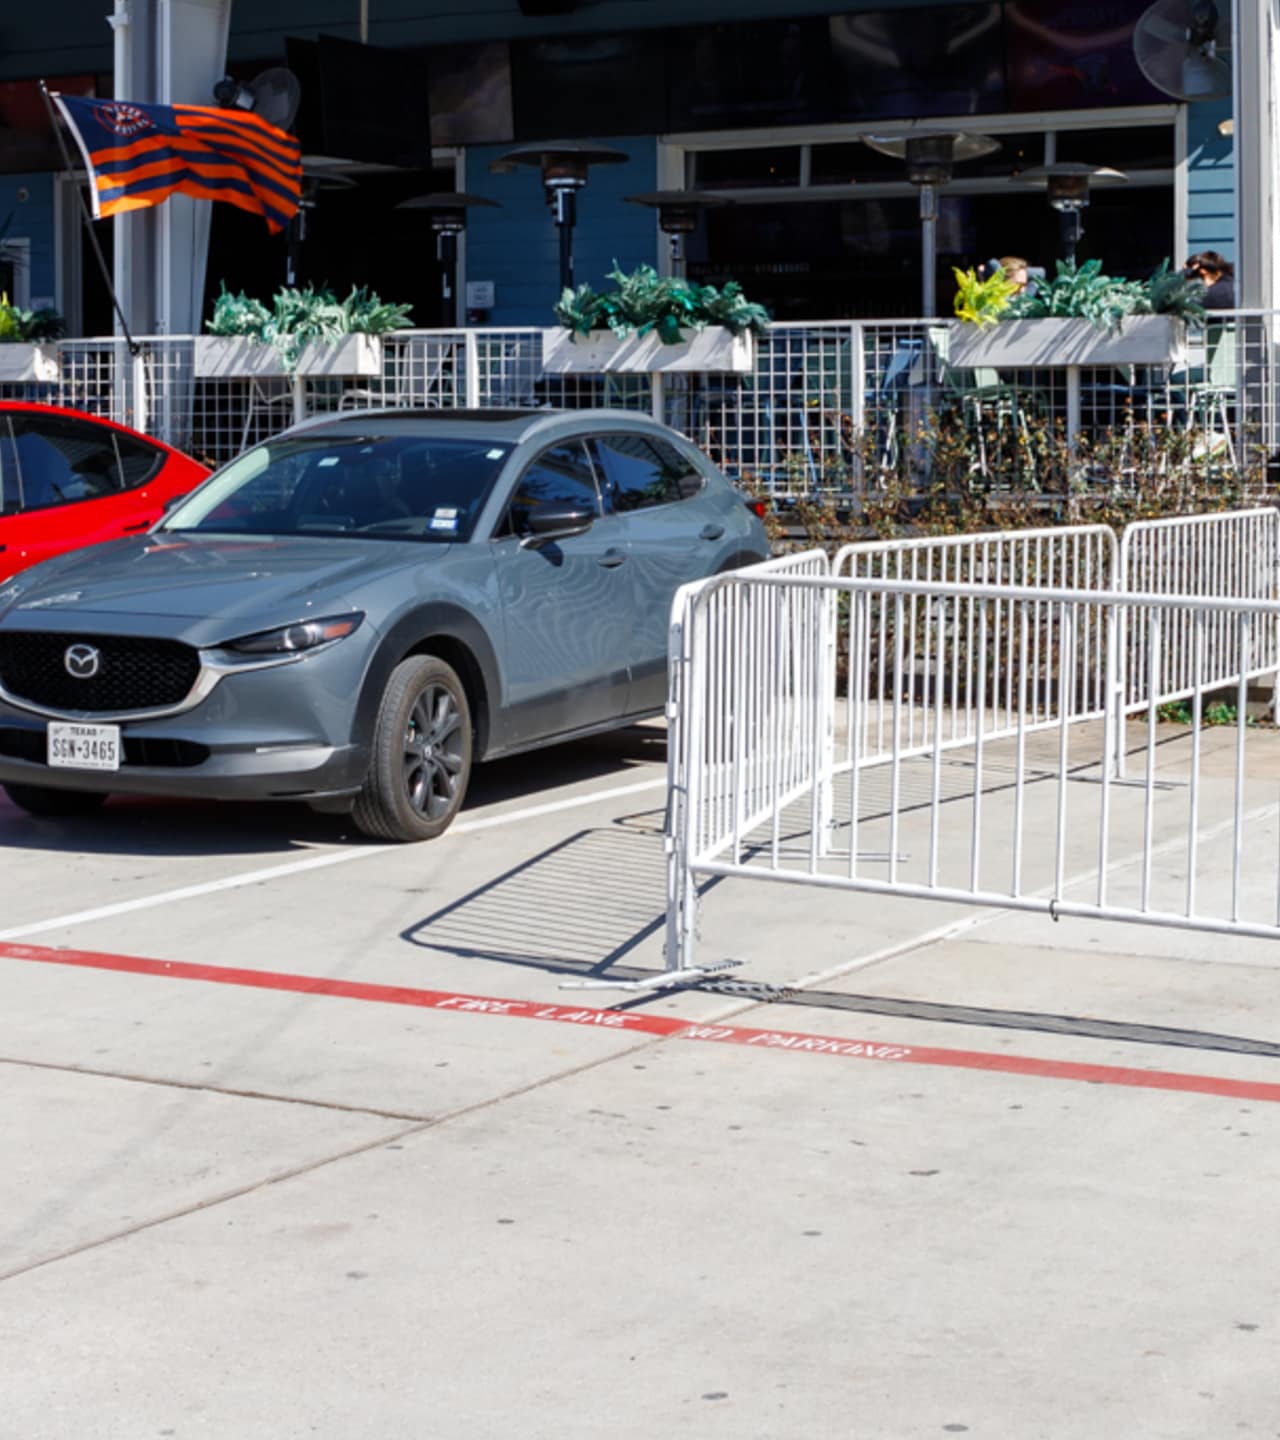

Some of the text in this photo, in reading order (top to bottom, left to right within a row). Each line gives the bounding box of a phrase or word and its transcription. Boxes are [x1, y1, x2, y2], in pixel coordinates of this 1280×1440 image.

[69, 726, 98, 737] TEXAS
[435, 996, 641, 1028] FIRE LANE
[747, 1032, 912, 1059] PARKING
